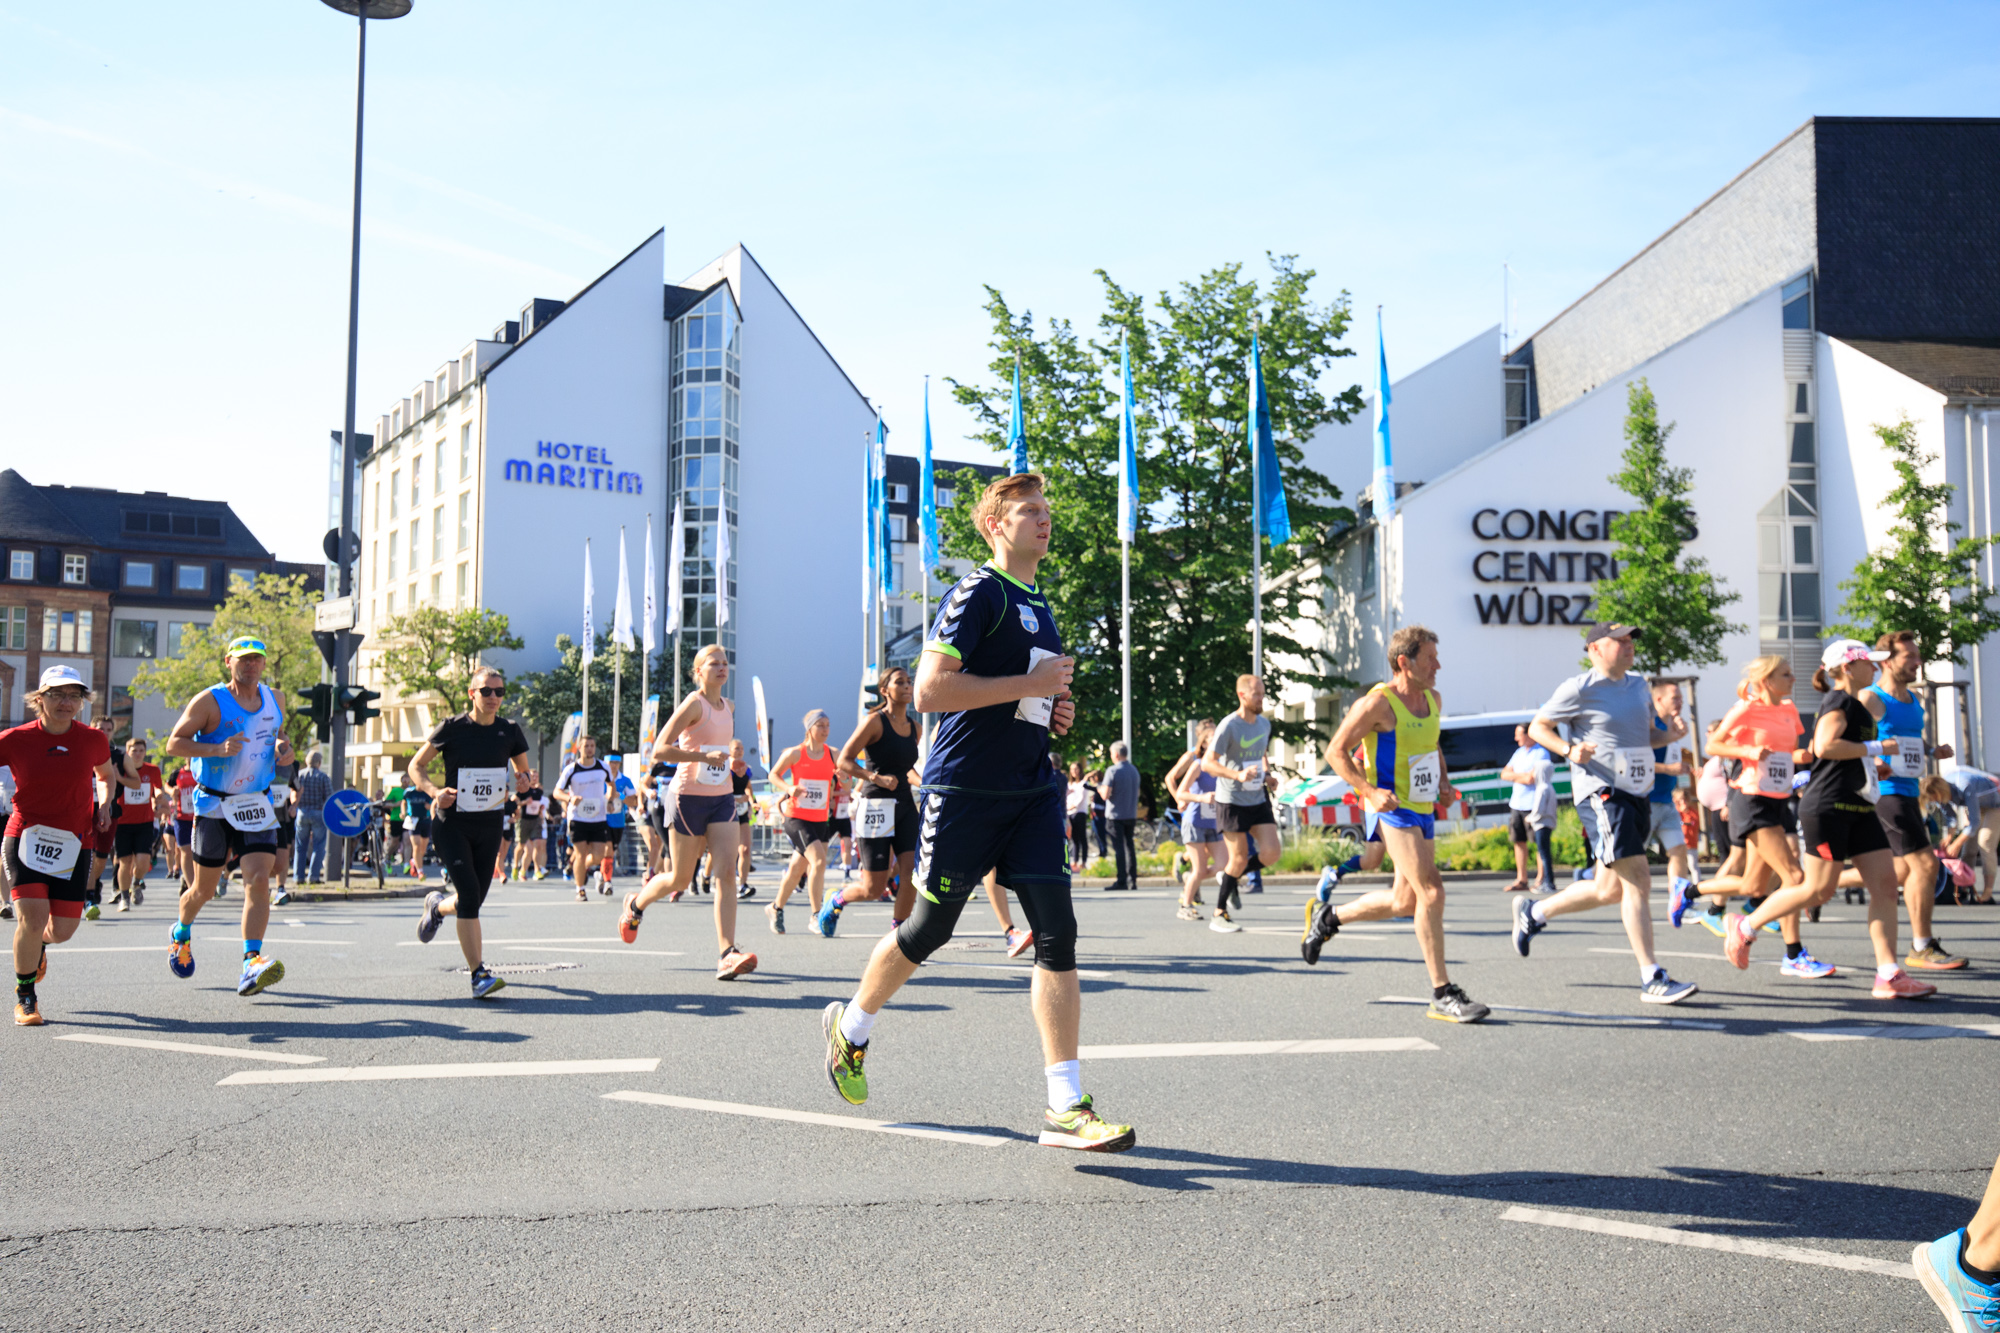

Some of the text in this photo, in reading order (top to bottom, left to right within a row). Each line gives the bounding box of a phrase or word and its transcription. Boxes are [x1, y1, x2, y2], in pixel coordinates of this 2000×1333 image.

[537, 440, 613, 465] HOTEL
[505, 459, 643, 495] MARITIM
[1630, 765, 1646, 777] 215
[1414, 773, 1431, 787] 204
[472, 785, 492, 796] 426
[233, 807, 266, 822] 10039
[34, 843, 62, 860] 1182
